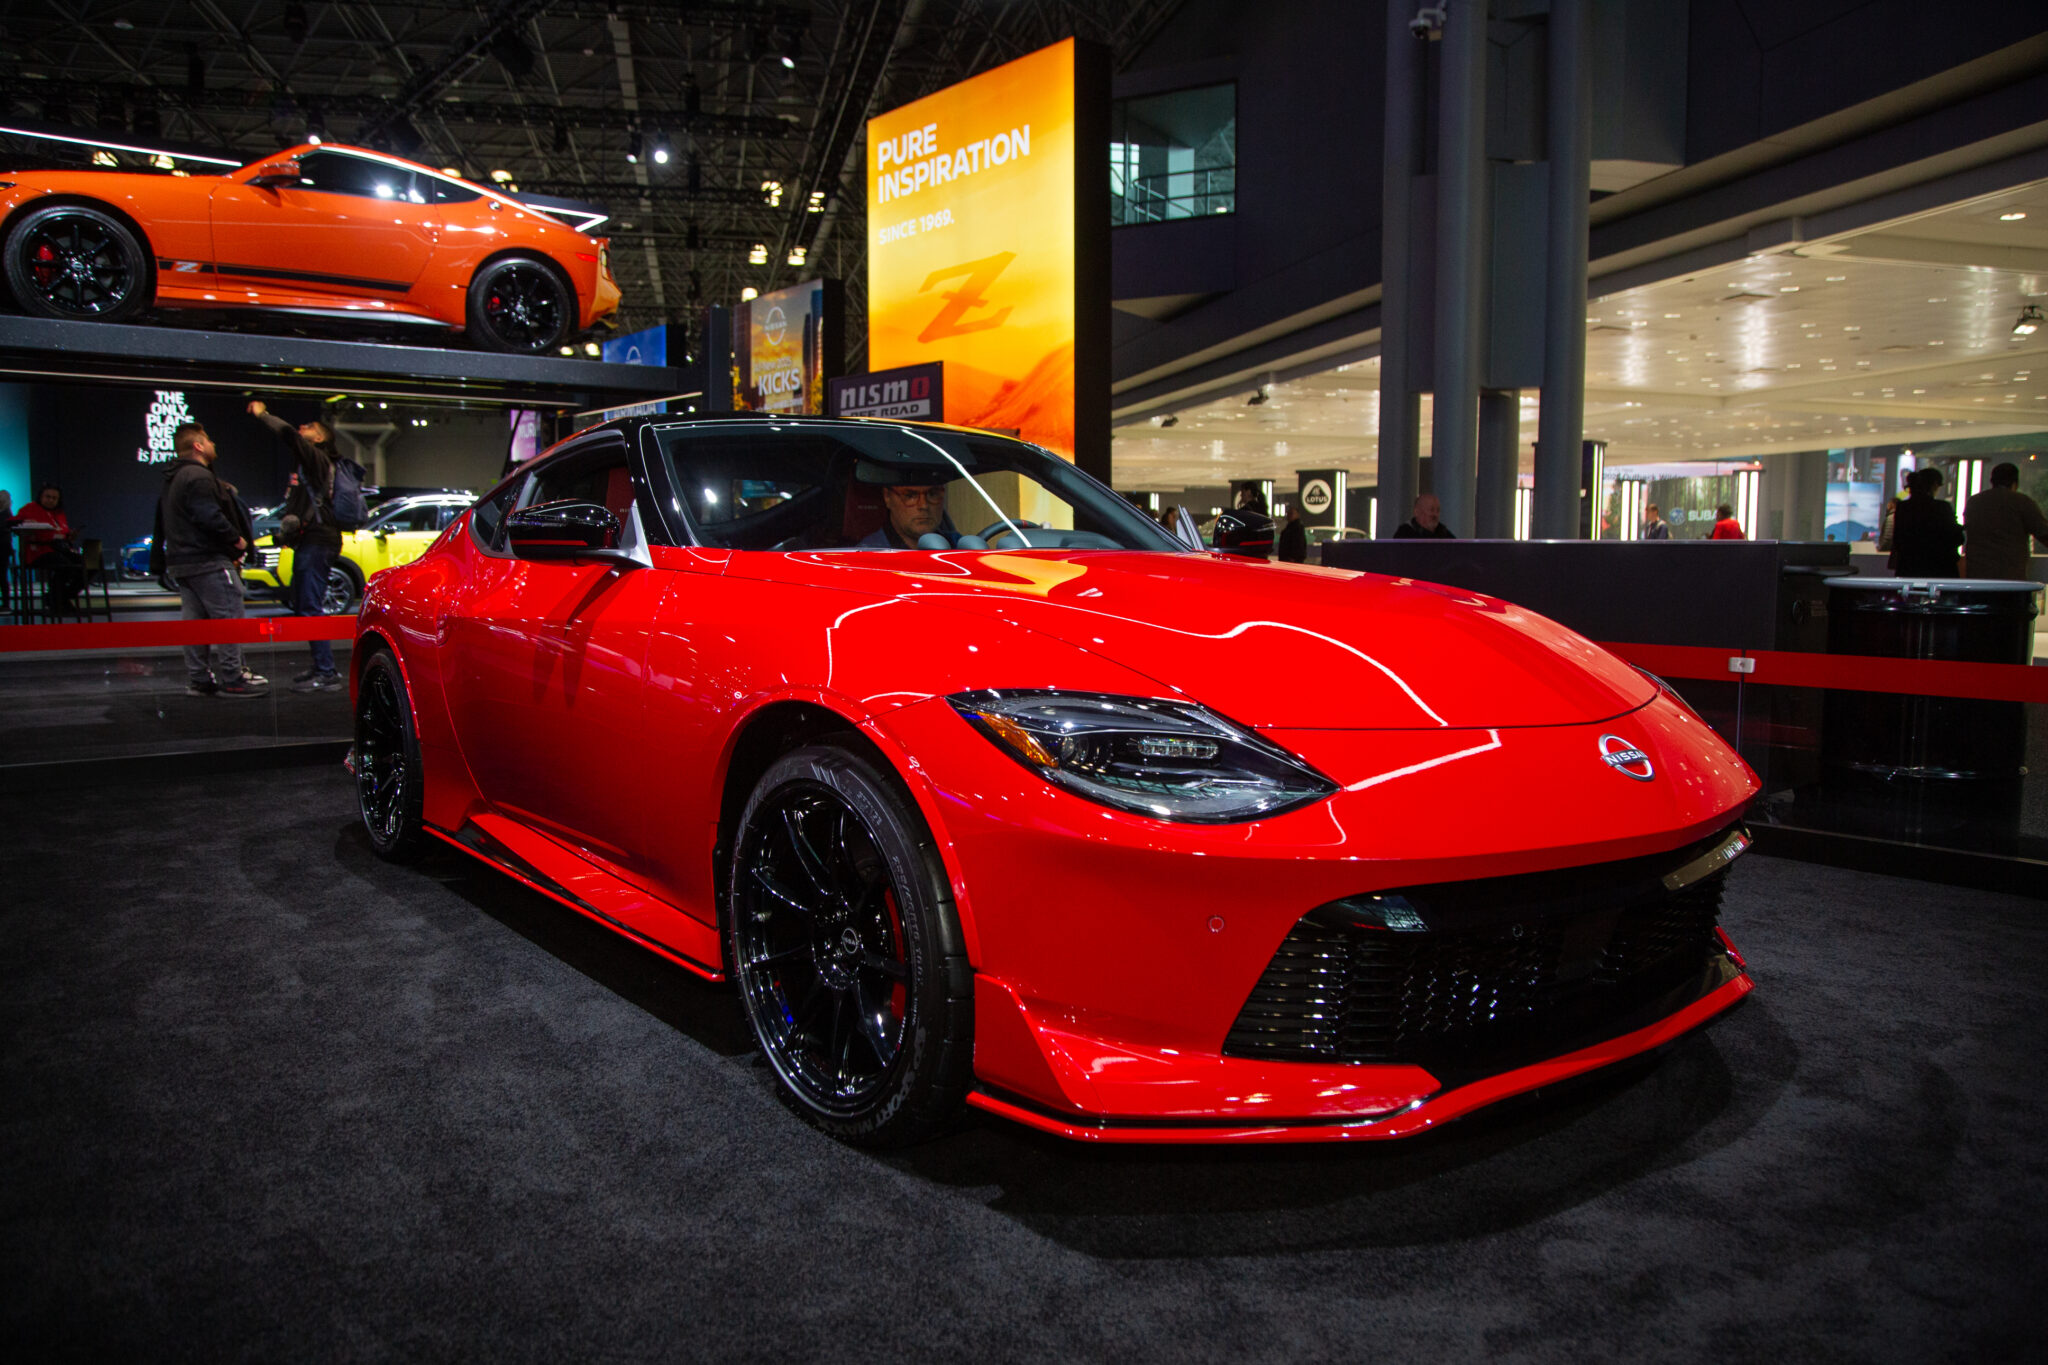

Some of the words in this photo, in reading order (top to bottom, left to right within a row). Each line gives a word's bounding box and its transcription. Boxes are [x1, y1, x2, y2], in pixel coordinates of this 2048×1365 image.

[878, 123, 938, 171] PURE
[878, 124, 1030, 204] INSPIRATION
[879, 218, 917, 245] SINCE
[919, 208, 955, 233] 1969.
[176, 261, 199, 273] Z
[758, 368, 801, 397] KICKS
[154, 390, 185, 404] THE
[150, 402, 190, 417] ONLY
[880, 404, 920, 417] ROAD
[148, 437, 175, 451] GOI
[1688, 509, 1718, 521] SUBA
